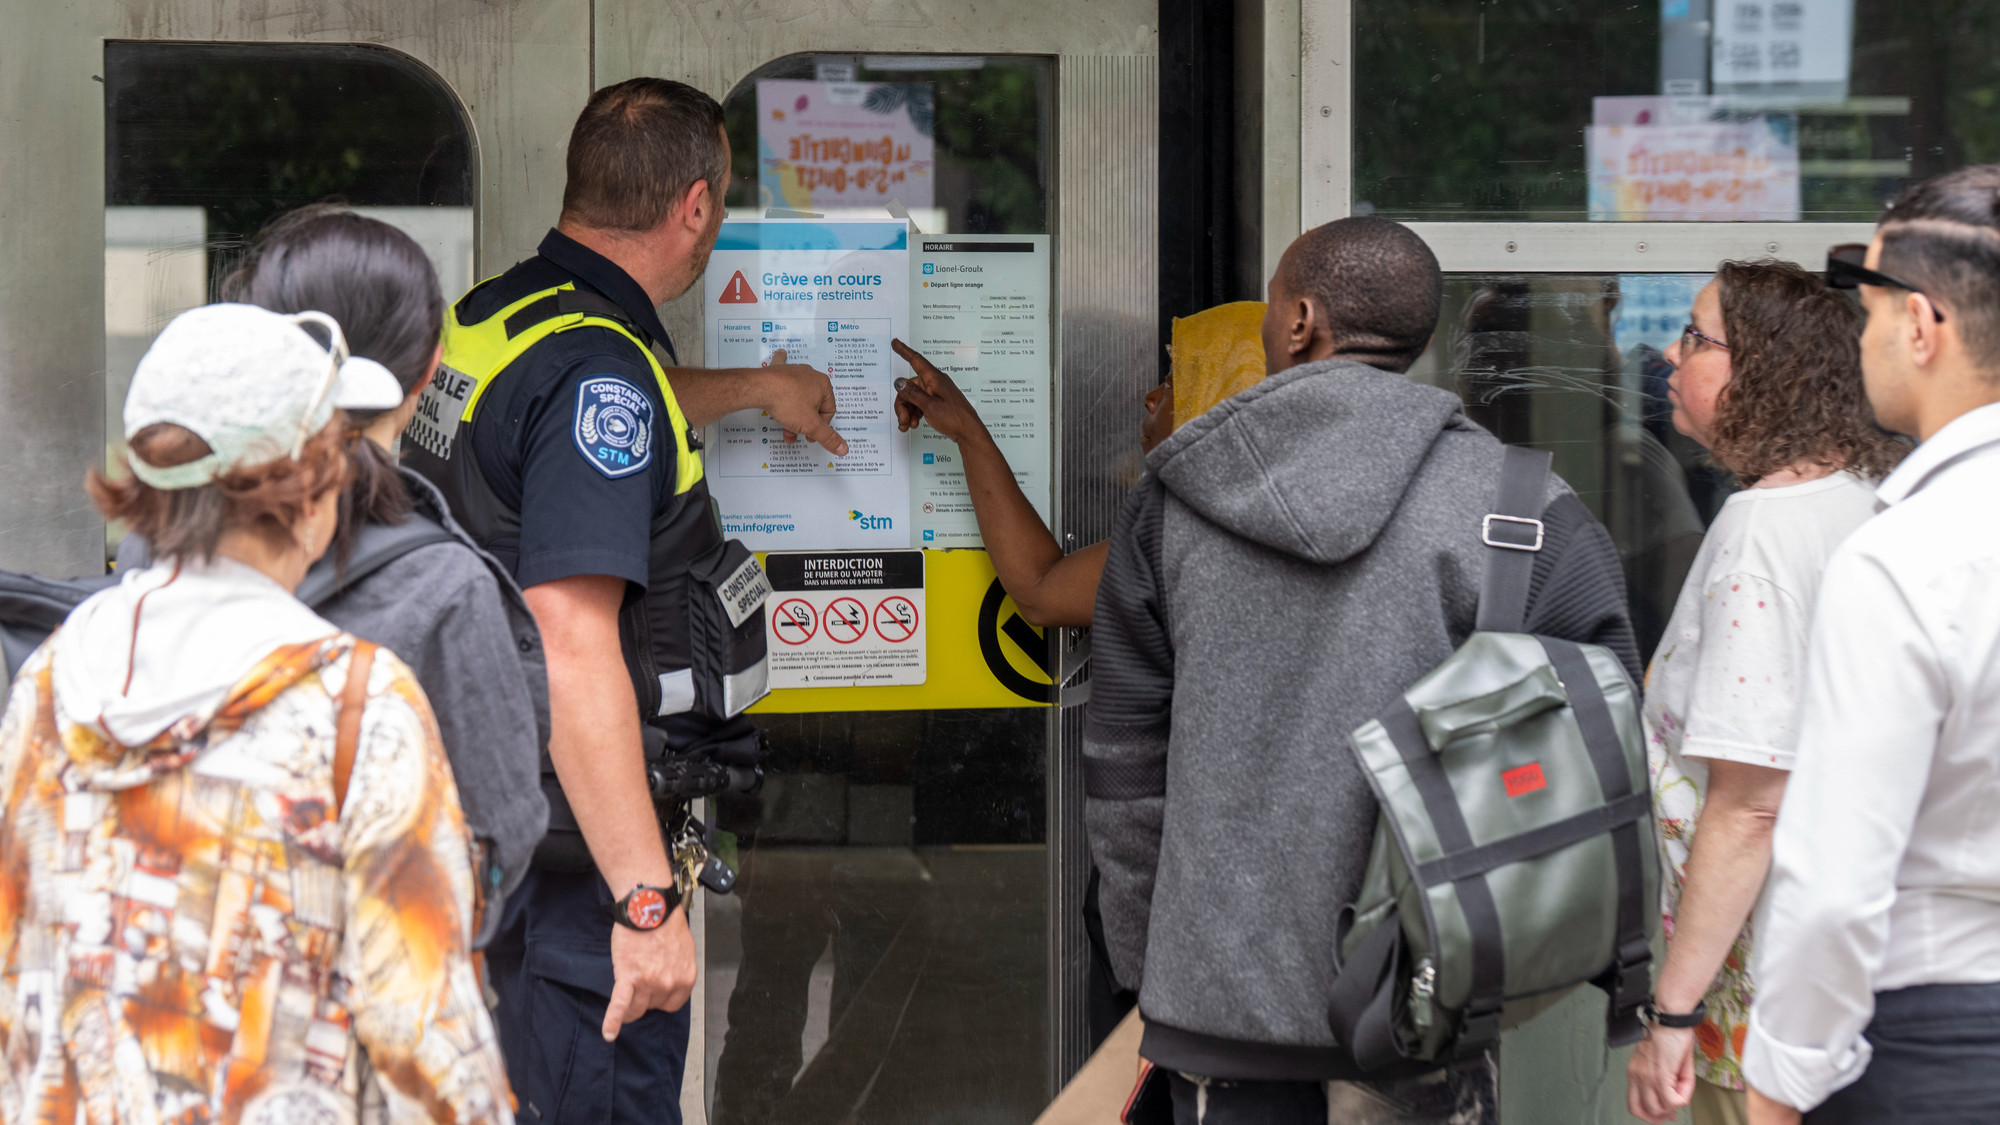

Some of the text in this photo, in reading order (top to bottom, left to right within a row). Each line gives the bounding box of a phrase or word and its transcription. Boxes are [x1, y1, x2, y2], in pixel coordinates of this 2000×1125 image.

[936, 265, 983, 273] Lionel-Groulx
[762, 272, 882, 286] Grève en cours
[764, 289, 874, 300] Horaires restreints
[590, 383, 648, 411] CONSTABLE
[598, 446, 629, 466] STM
[936, 454, 952, 463] Vélo
[722, 522, 795, 534] stm.info/greve
[860, 514, 893, 530] stm
[804, 558, 883, 570] INTERDICTION
[804, 571, 813, 579] DE
[840, 570, 851, 578] OU
[852, 570, 883, 578] VAPOTER
[723, 560, 761, 602] CONSTABLE
